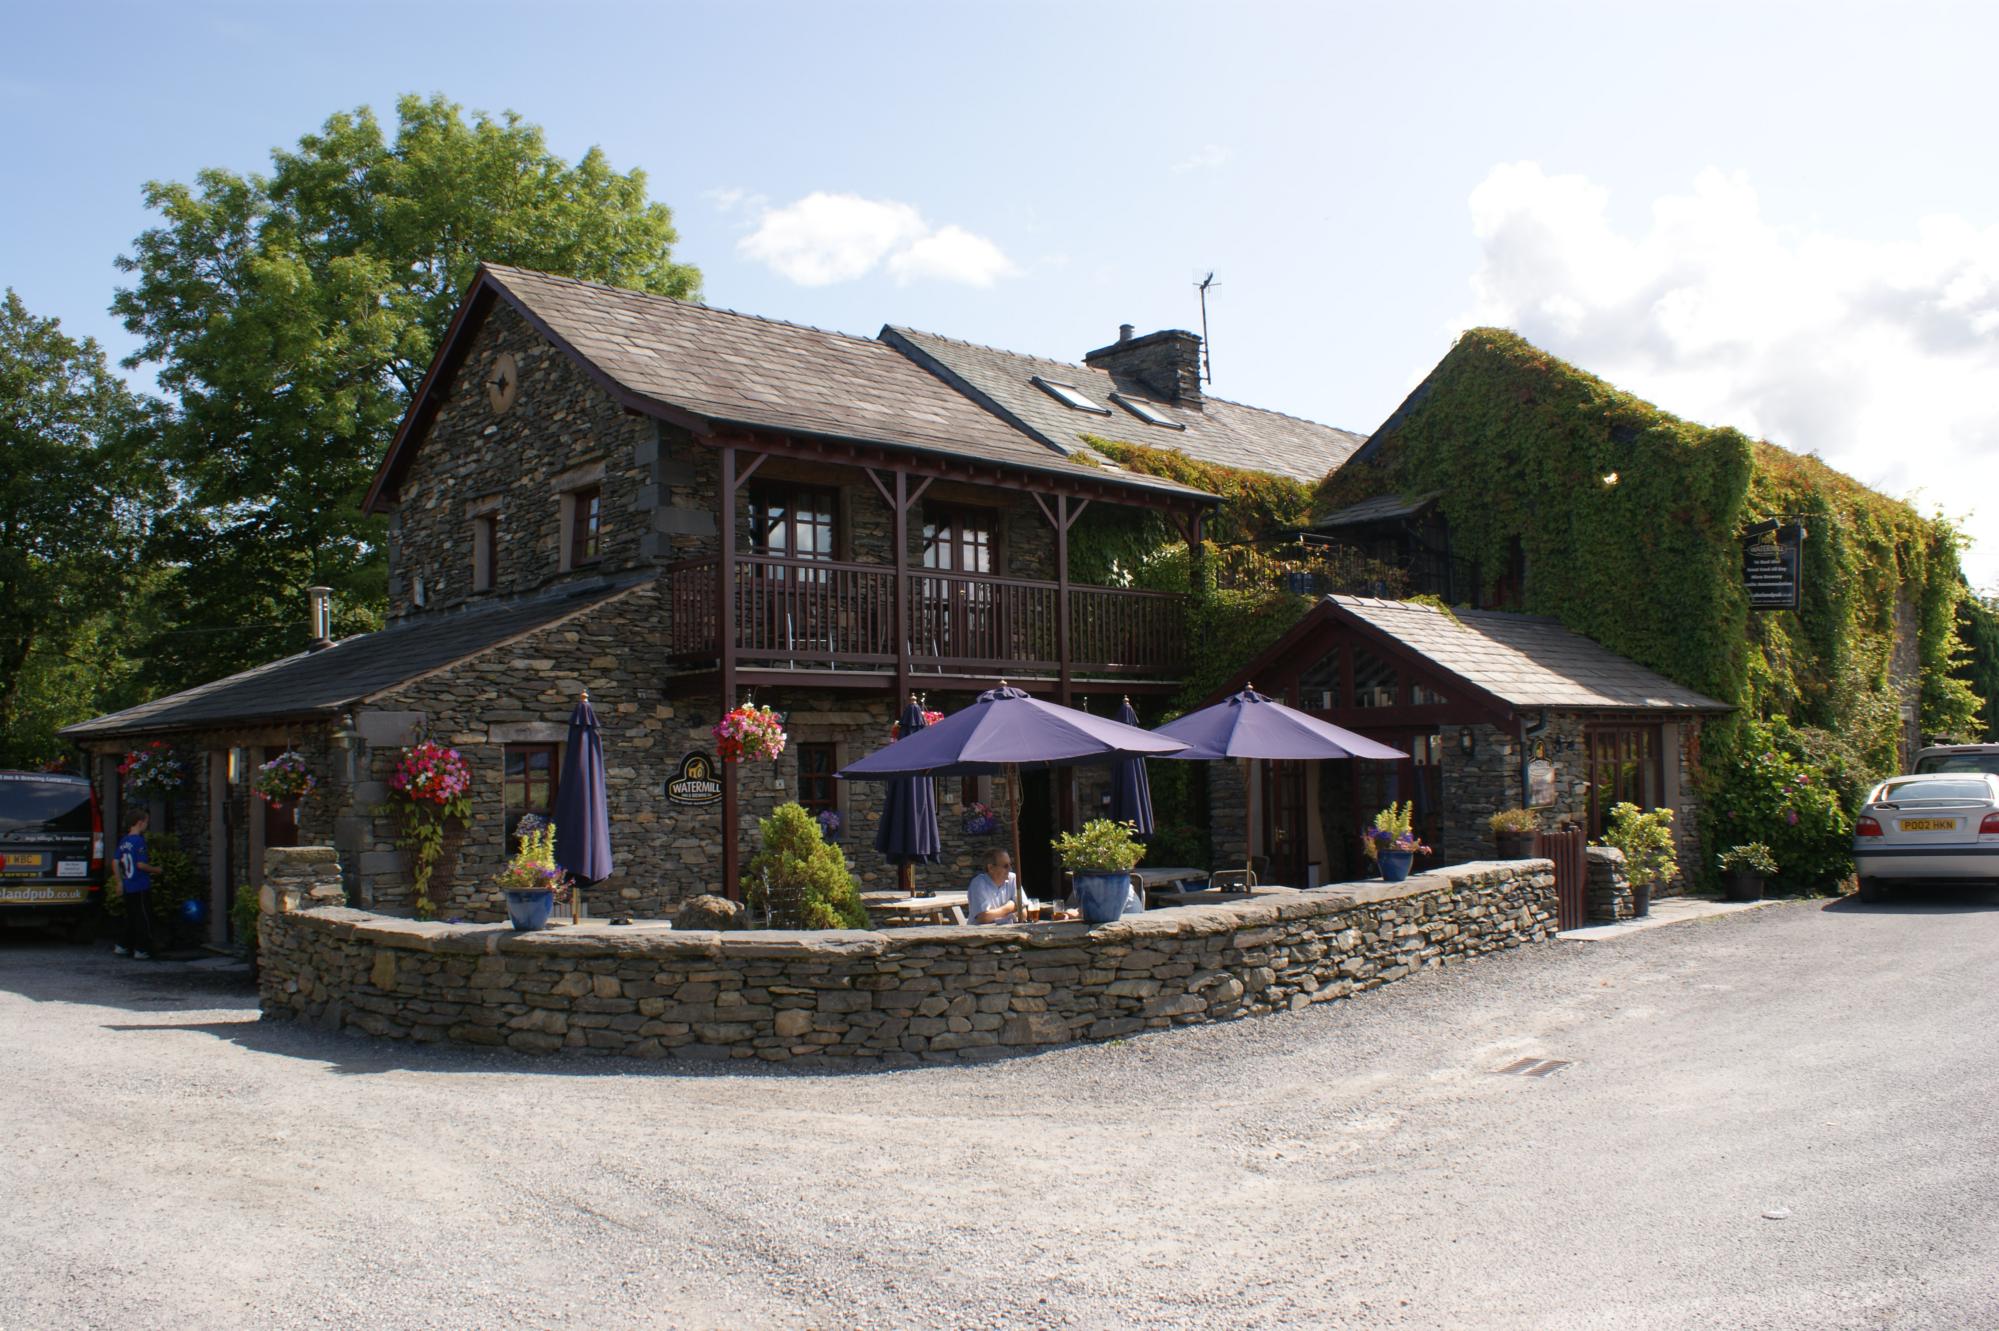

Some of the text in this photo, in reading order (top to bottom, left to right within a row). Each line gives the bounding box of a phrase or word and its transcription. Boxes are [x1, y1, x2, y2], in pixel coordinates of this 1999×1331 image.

[672, 781, 721, 793] WATERMILL
[1933, 820, 1953, 830] HKN
[14, 855, 33, 864] WBC
